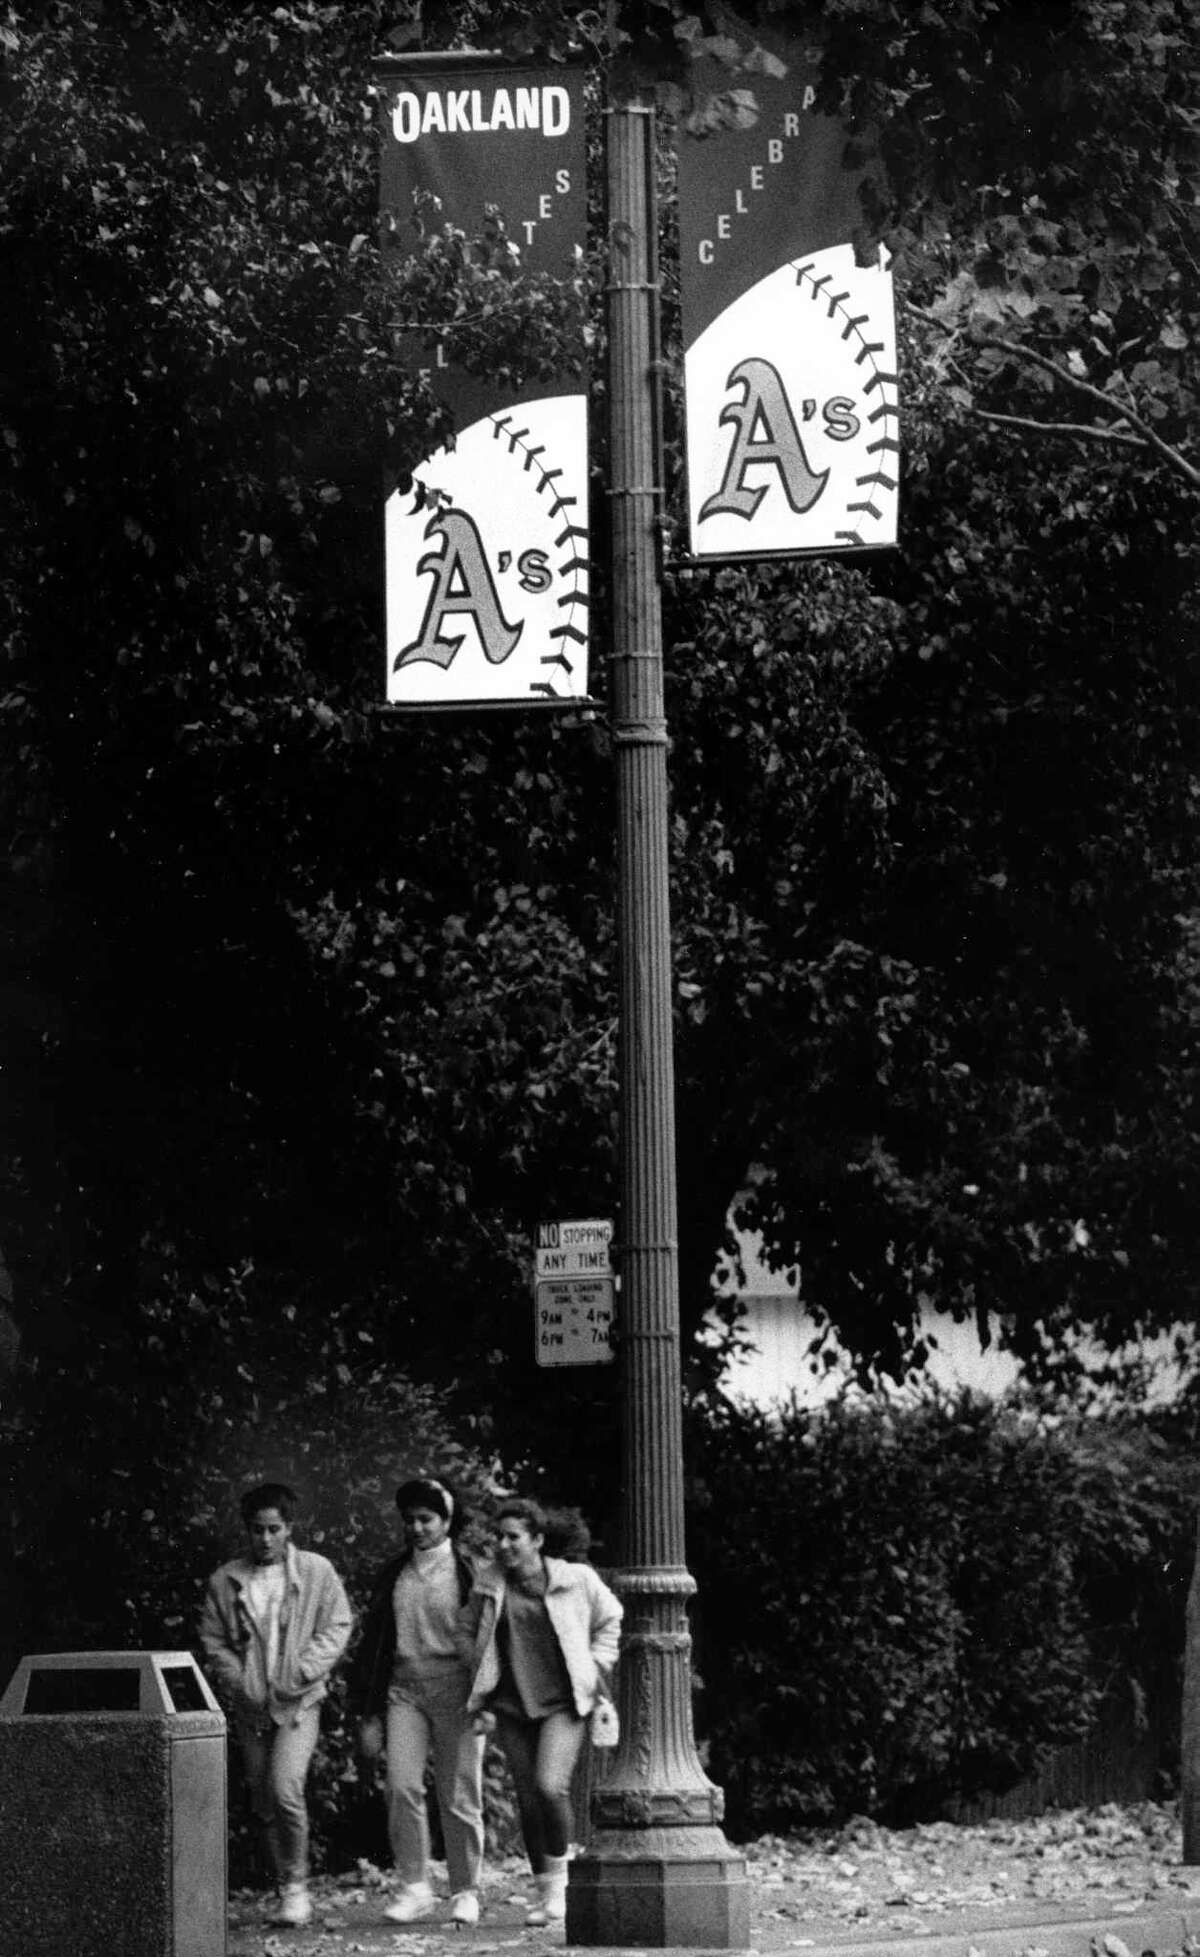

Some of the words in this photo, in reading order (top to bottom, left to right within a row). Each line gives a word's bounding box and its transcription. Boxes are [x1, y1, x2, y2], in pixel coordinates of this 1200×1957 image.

[393, 86, 570, 142] OAKLAND
[699, 85, 816, 264] CELEBRA
[698, 357, 861, 525] A's
[393, 507, 553, 673] A's
[539, 1224, 559, 1247] NO
[563, 1226, 610, 1245] STOPPING
[543, 1255, 567, 1270] ANY
[578, 1252, 606, 1268] TIME
